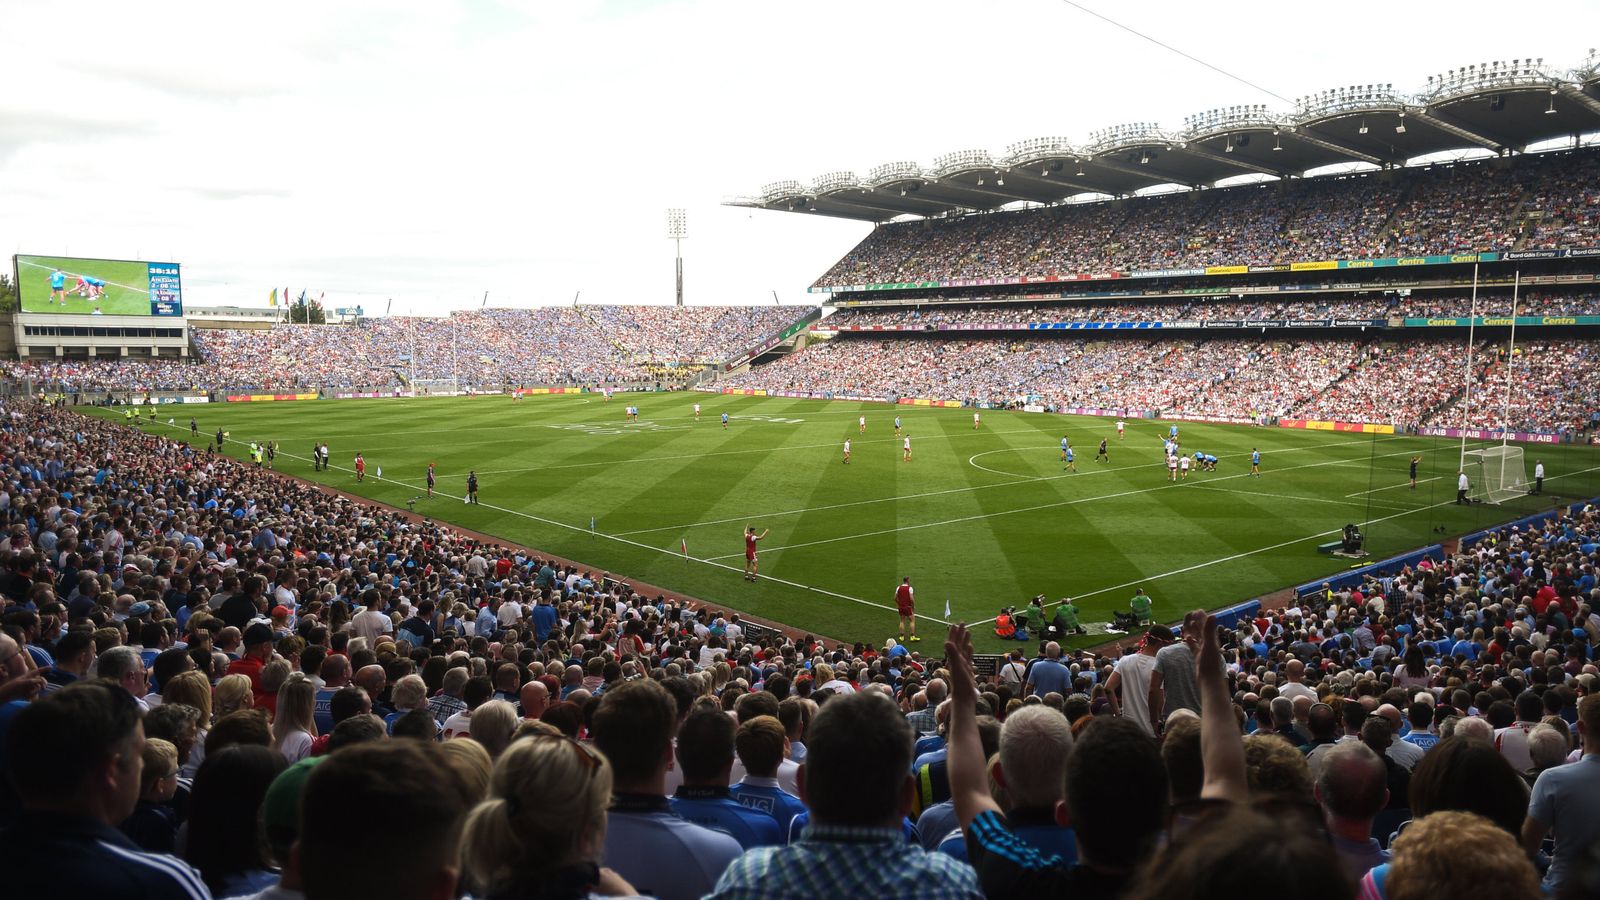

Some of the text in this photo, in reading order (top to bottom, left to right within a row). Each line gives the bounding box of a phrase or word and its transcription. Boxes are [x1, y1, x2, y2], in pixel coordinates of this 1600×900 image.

[1427, 318, 1456, 326] Centra
[1542, 317, 1576, 325] Centra
[1536, 434, 1552, 442] AIB
[316, 702, 331, 711] AIG
[742, 797, 769, 811] AIG
